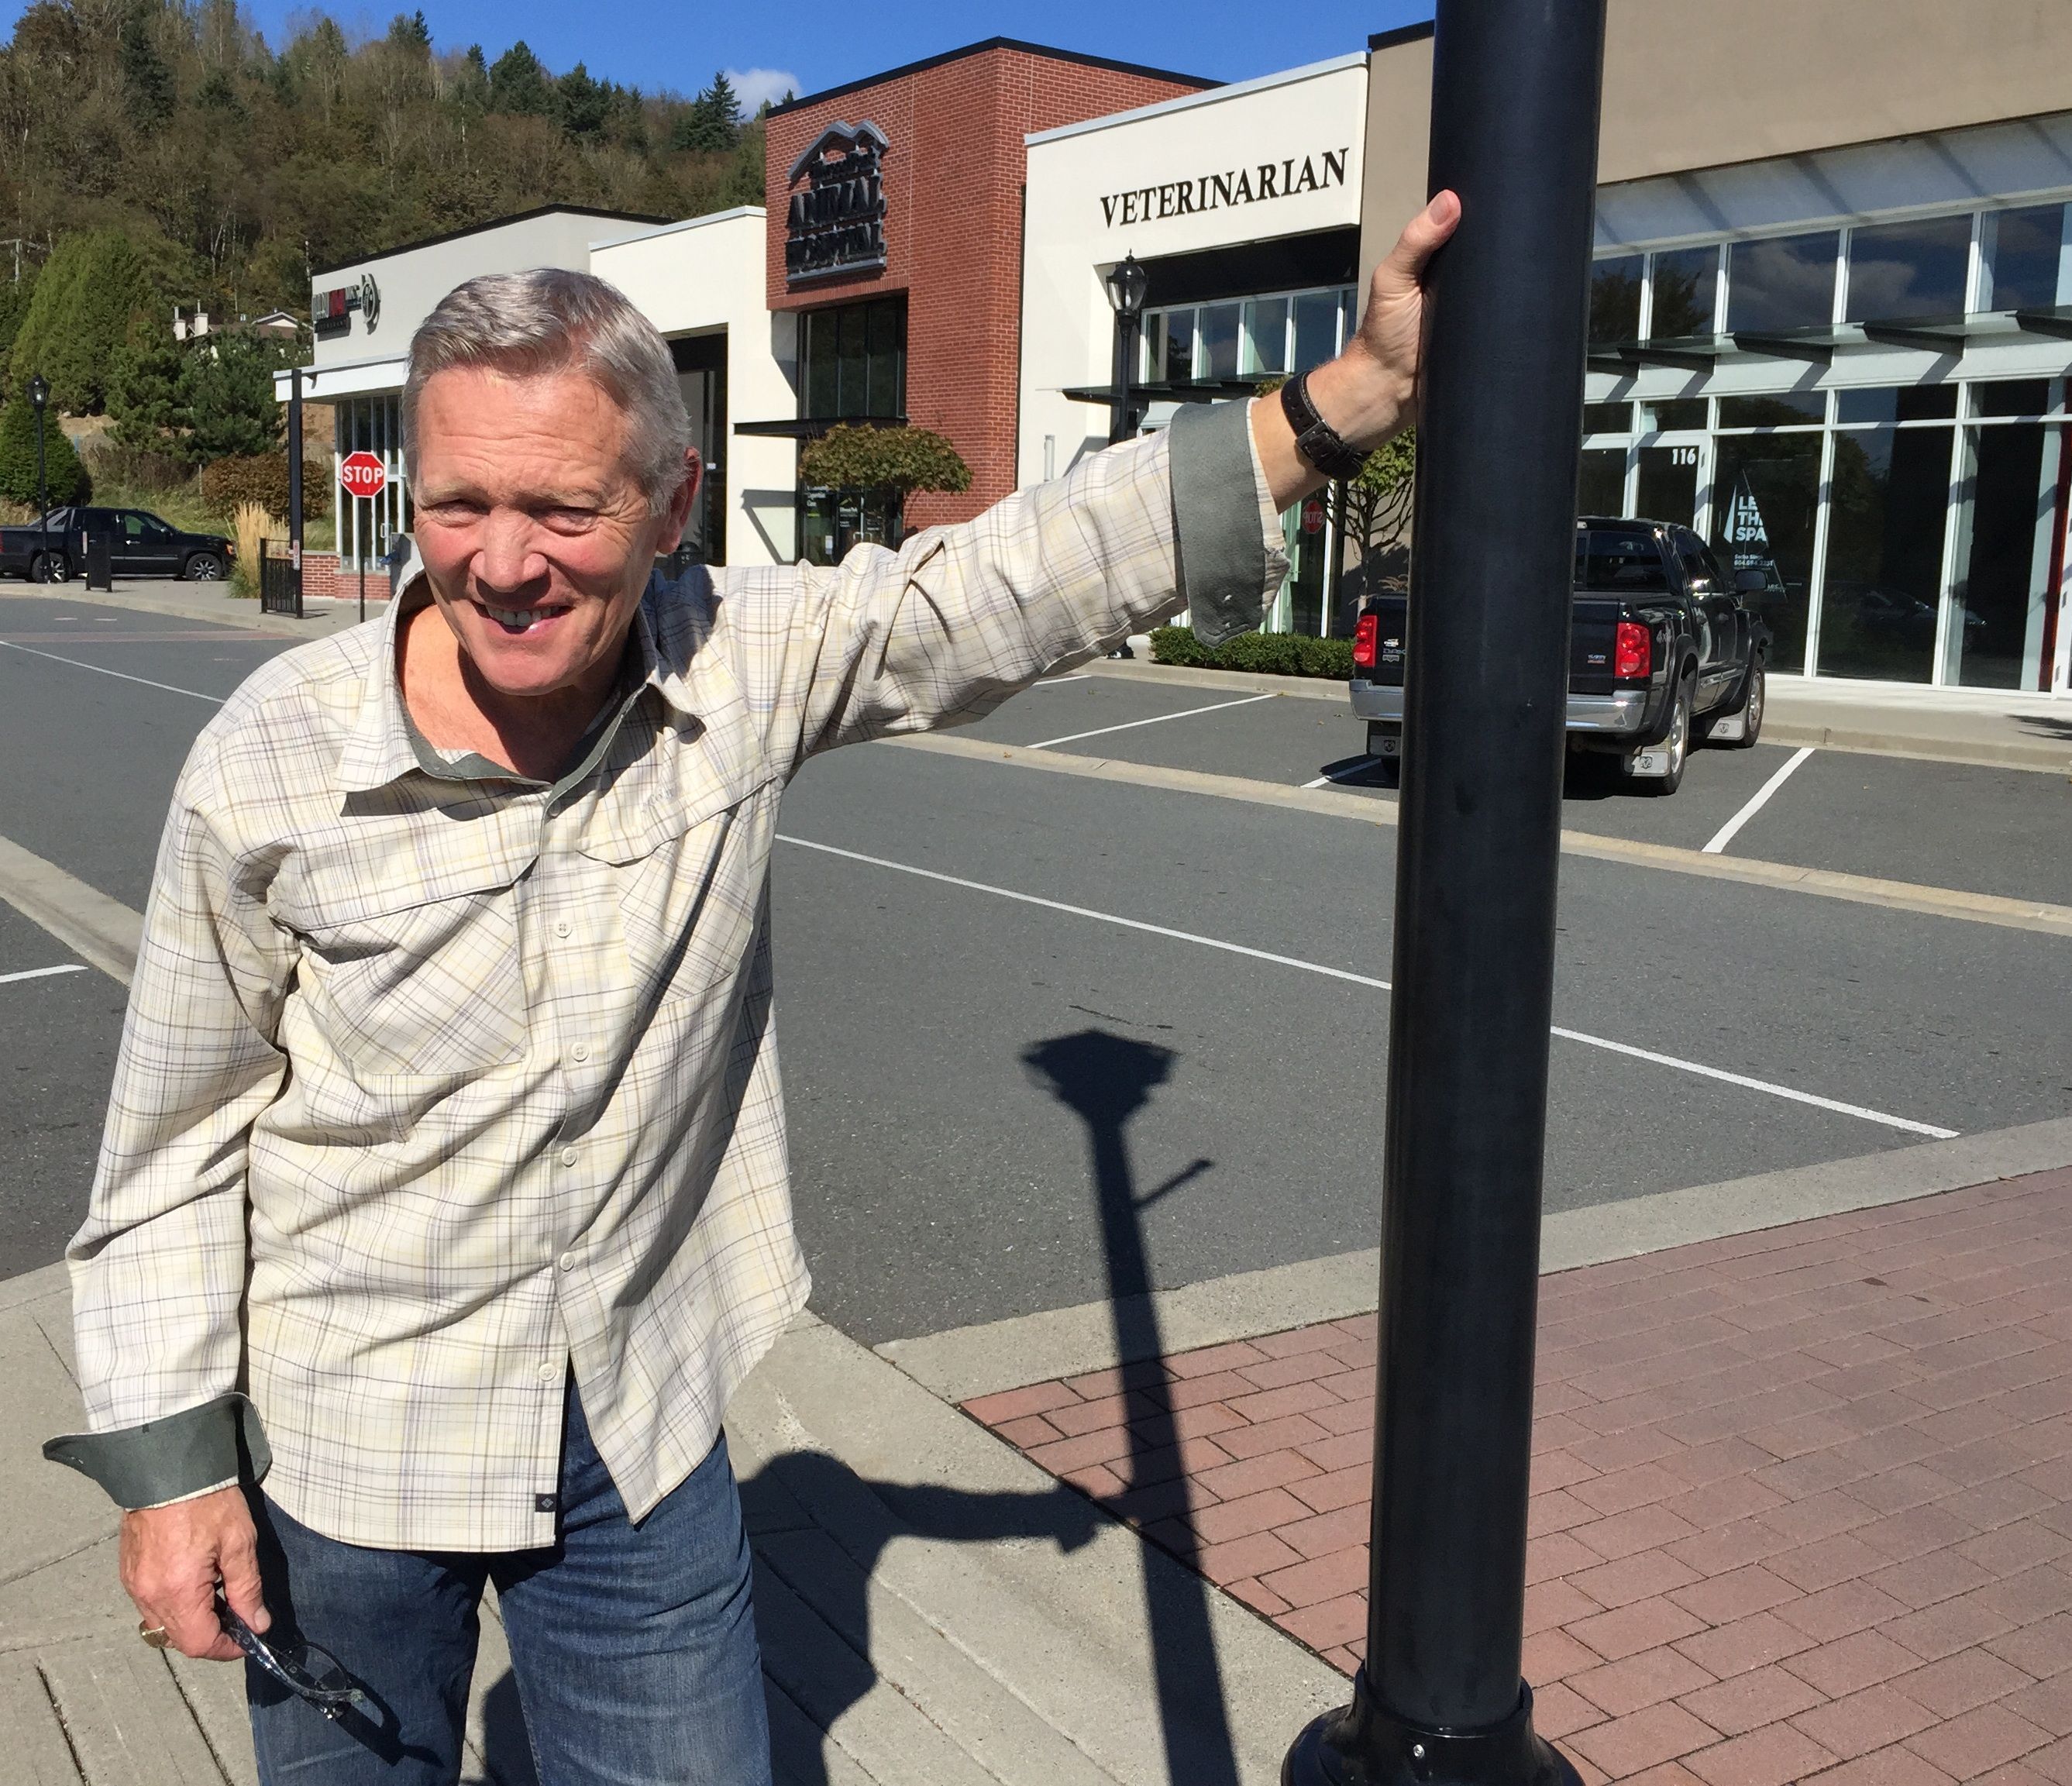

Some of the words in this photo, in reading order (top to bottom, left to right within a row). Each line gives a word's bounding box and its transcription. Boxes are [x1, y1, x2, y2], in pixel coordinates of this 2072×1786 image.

[1100, 147, 1349, 229] VETERINARIAN
[1672, 448, 1696, 465] 116
[343, 466, 384, 483] STOP
[1736, 527, 1767, 541] SPA
